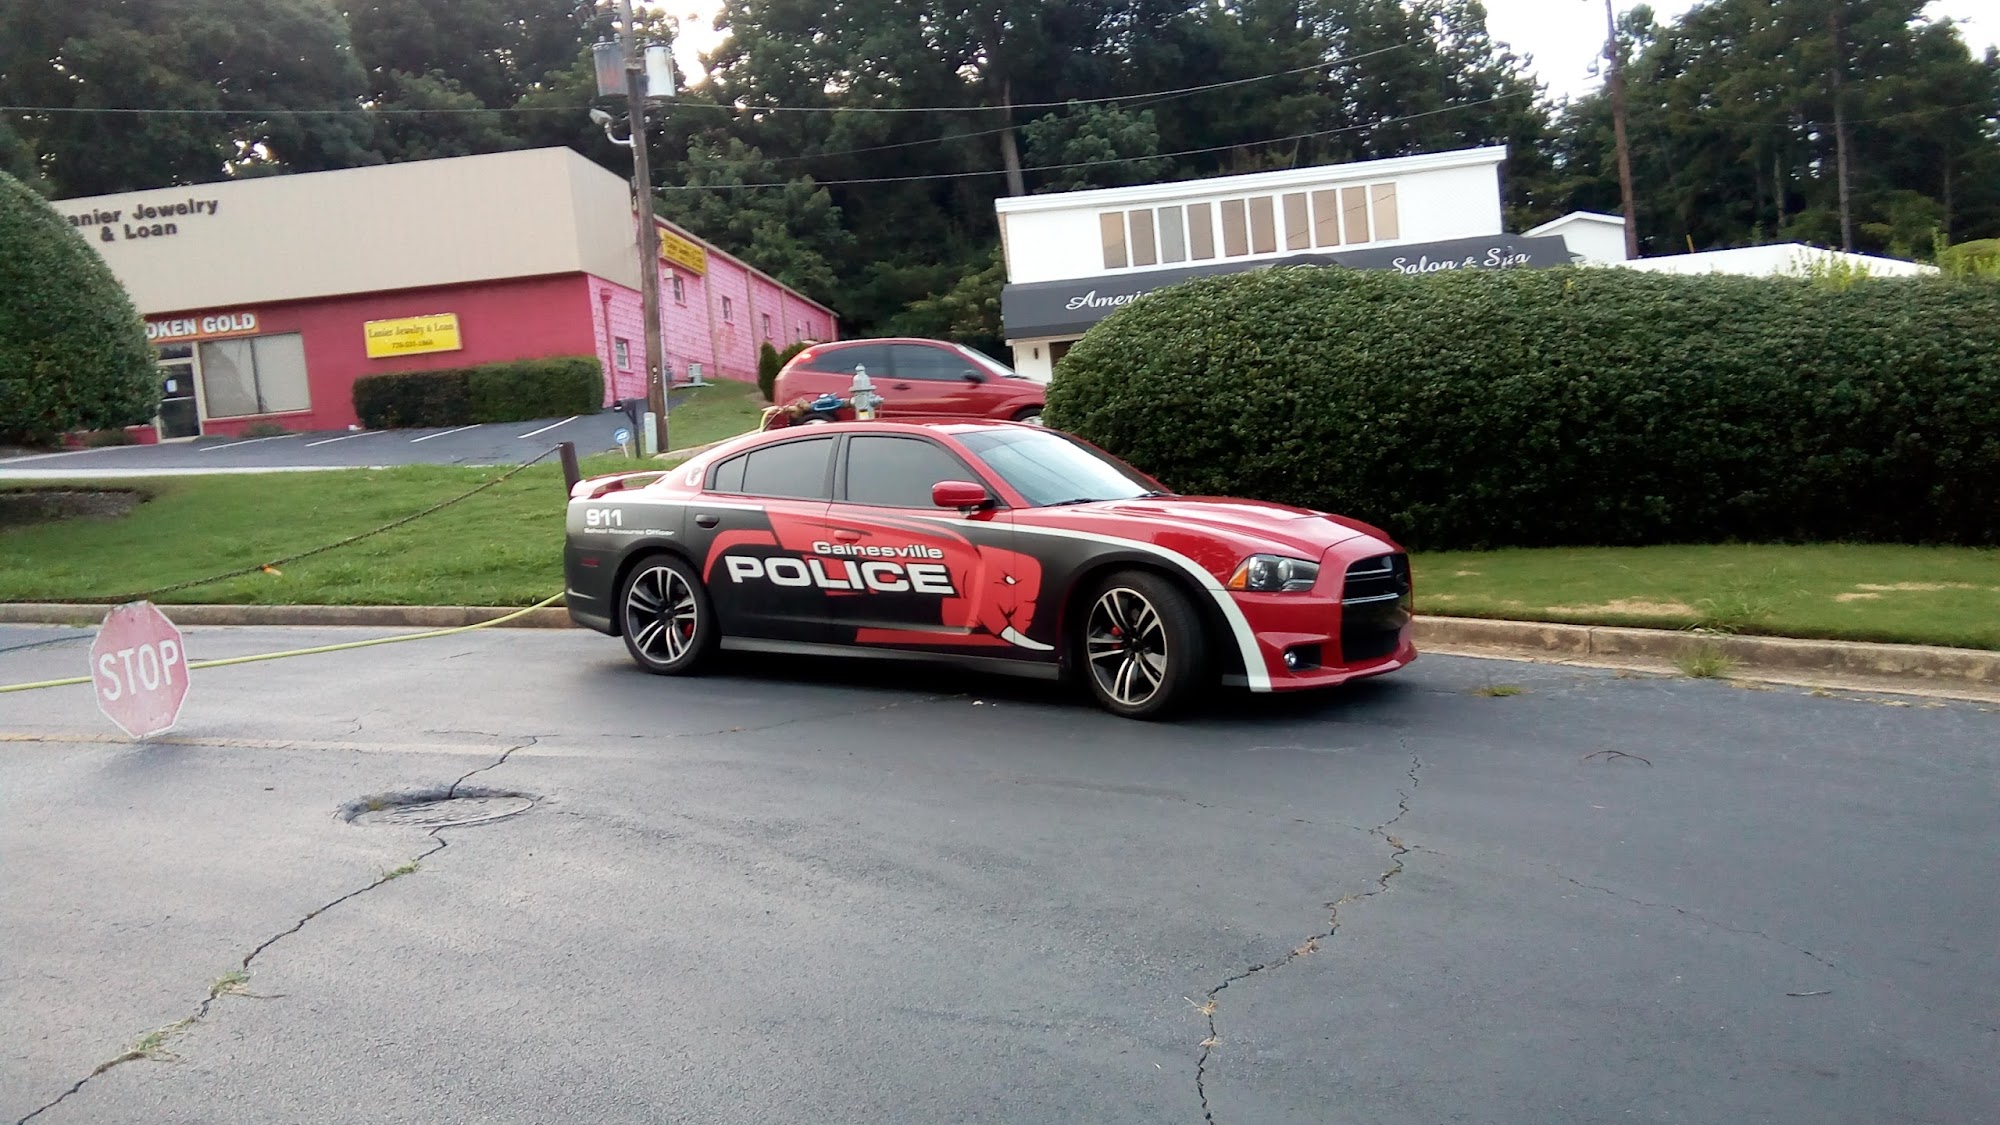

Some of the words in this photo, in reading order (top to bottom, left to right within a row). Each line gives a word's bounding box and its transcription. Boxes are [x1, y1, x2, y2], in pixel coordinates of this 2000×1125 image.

[68, 209, 121, 226] anier
[132, 199, 218, 220] Jewelry
[101, 226, 115, 242] &
[124, 222, 177, 239] Loan
[1392, 255, 1458, 274] Salon
[1462, 257, 1478, 268] &
[1065, 290, 1153, 310] Ameri
[145, 318, 197, 339] OKEN
[202, 313, 255, 333] GOLD
[586, 508, 622, 526] 911
[812, 541, 943, 559] Gainesville
[725, 556, 955, 594] POLICE
[99, 640, 178, 700] STOP
